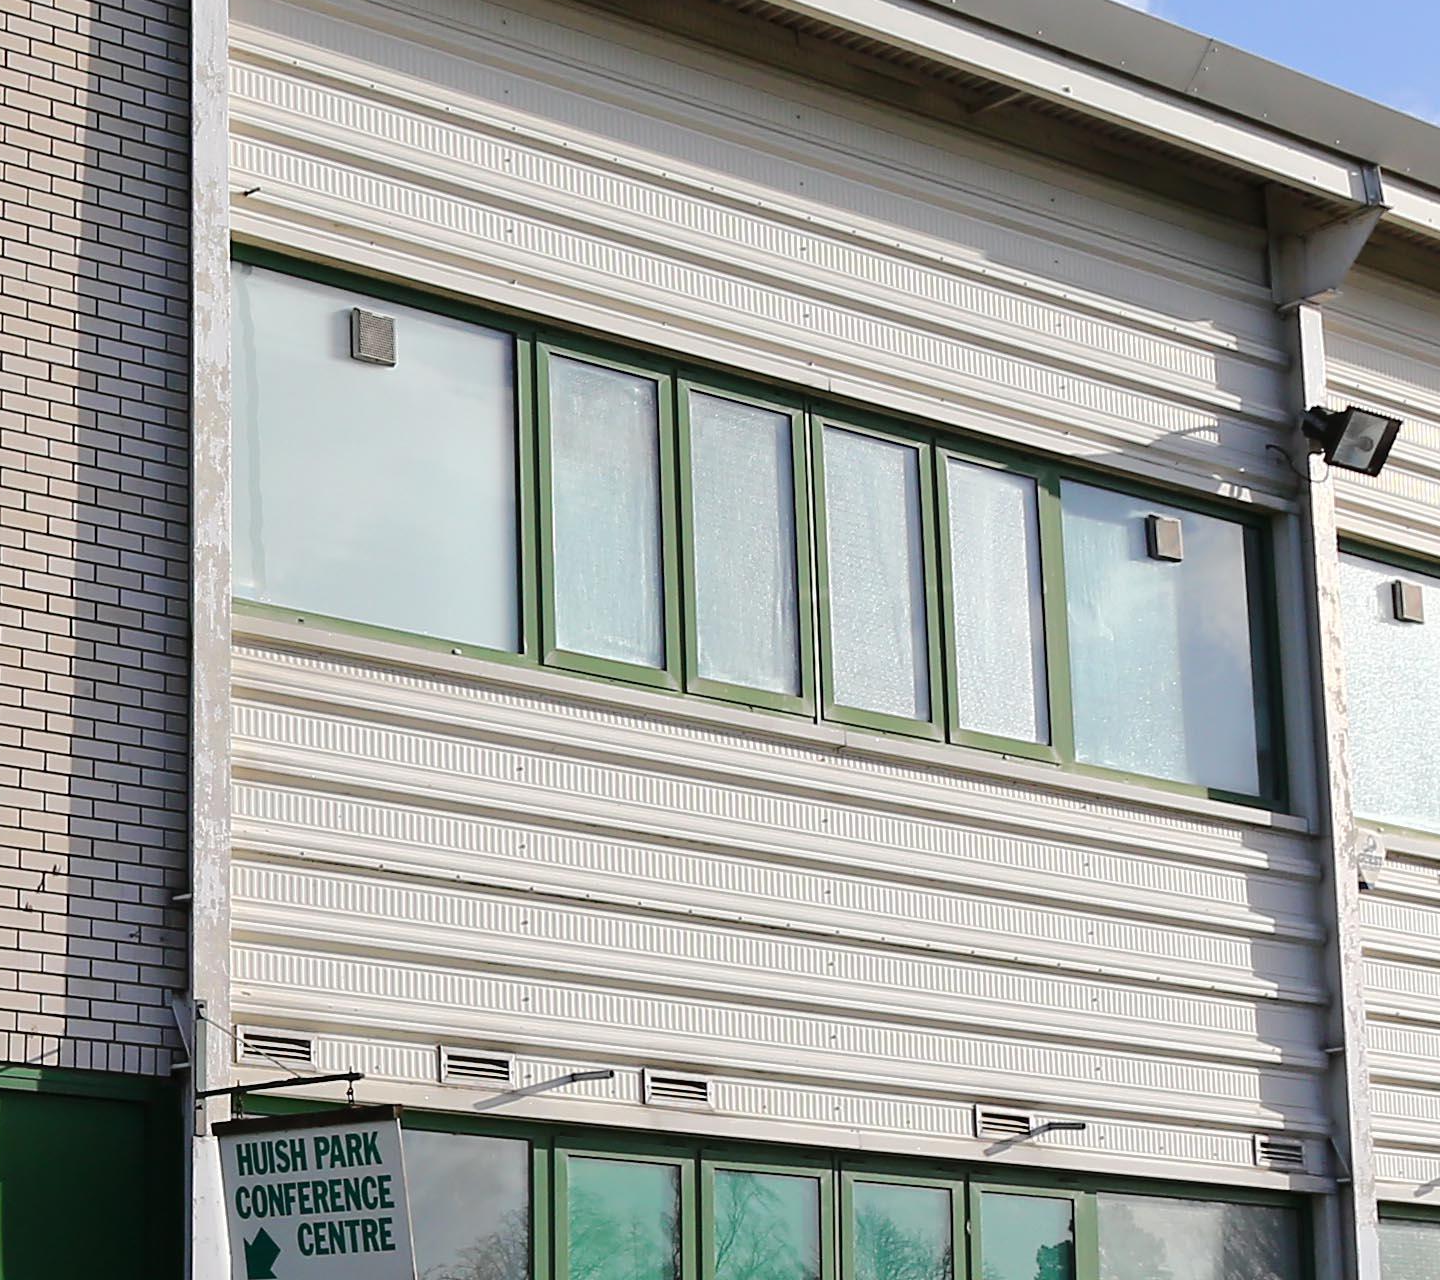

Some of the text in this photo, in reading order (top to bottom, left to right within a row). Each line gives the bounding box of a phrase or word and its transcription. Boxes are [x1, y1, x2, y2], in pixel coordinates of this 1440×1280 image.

[236, 1131, 383, 1176] HUISH PARK
[235, 1174, 395, 1220] CONFERENCE
[297, 1217, 396, 1257] CENTRE
